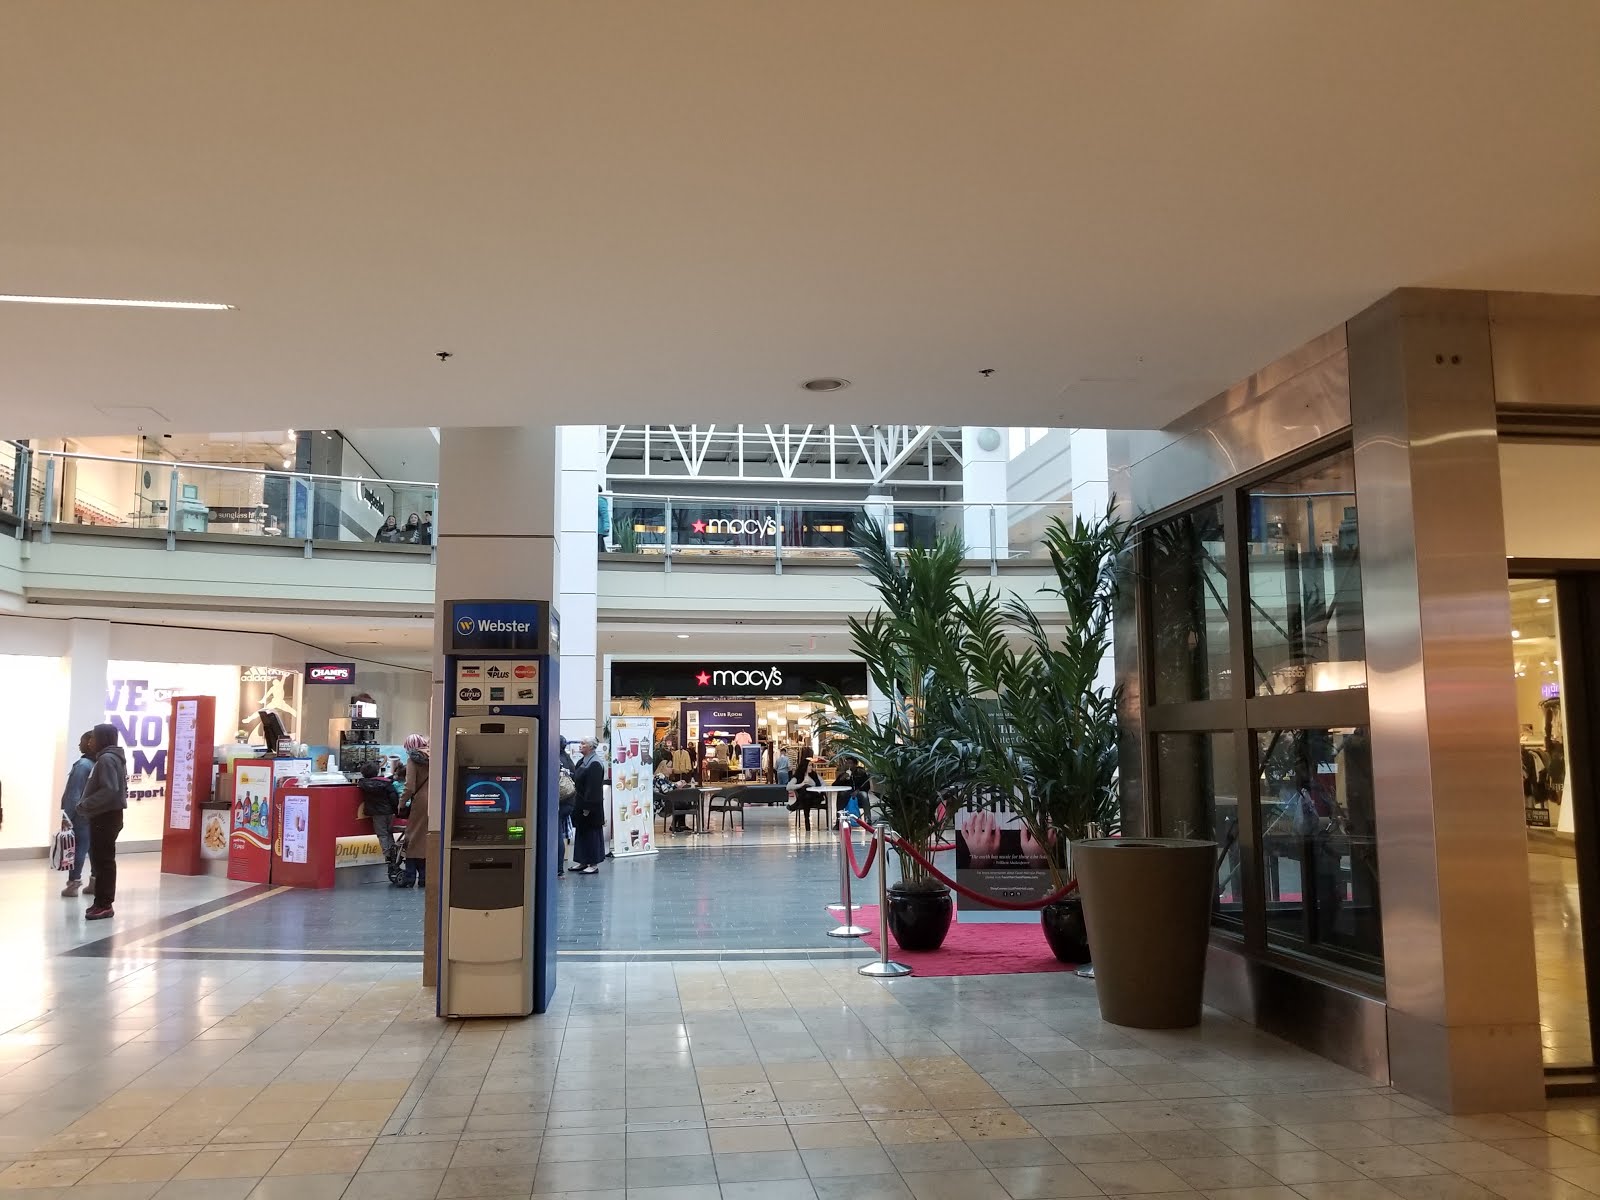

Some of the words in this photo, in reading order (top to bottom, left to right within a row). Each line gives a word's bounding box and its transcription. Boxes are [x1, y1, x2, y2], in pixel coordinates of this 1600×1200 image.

[218, 511, 248, 520] sunglass
[708, 515, 777, 539] macy's
[478, 619, 531, 633] Webster
[311, 668, 349, 678] CHAMPS
[492, 671, 510, 679] PLUS
[713, 666, 782, 690] macy's
[335, 843, 360, 858] Only
[362, 842, 378, 855] the
